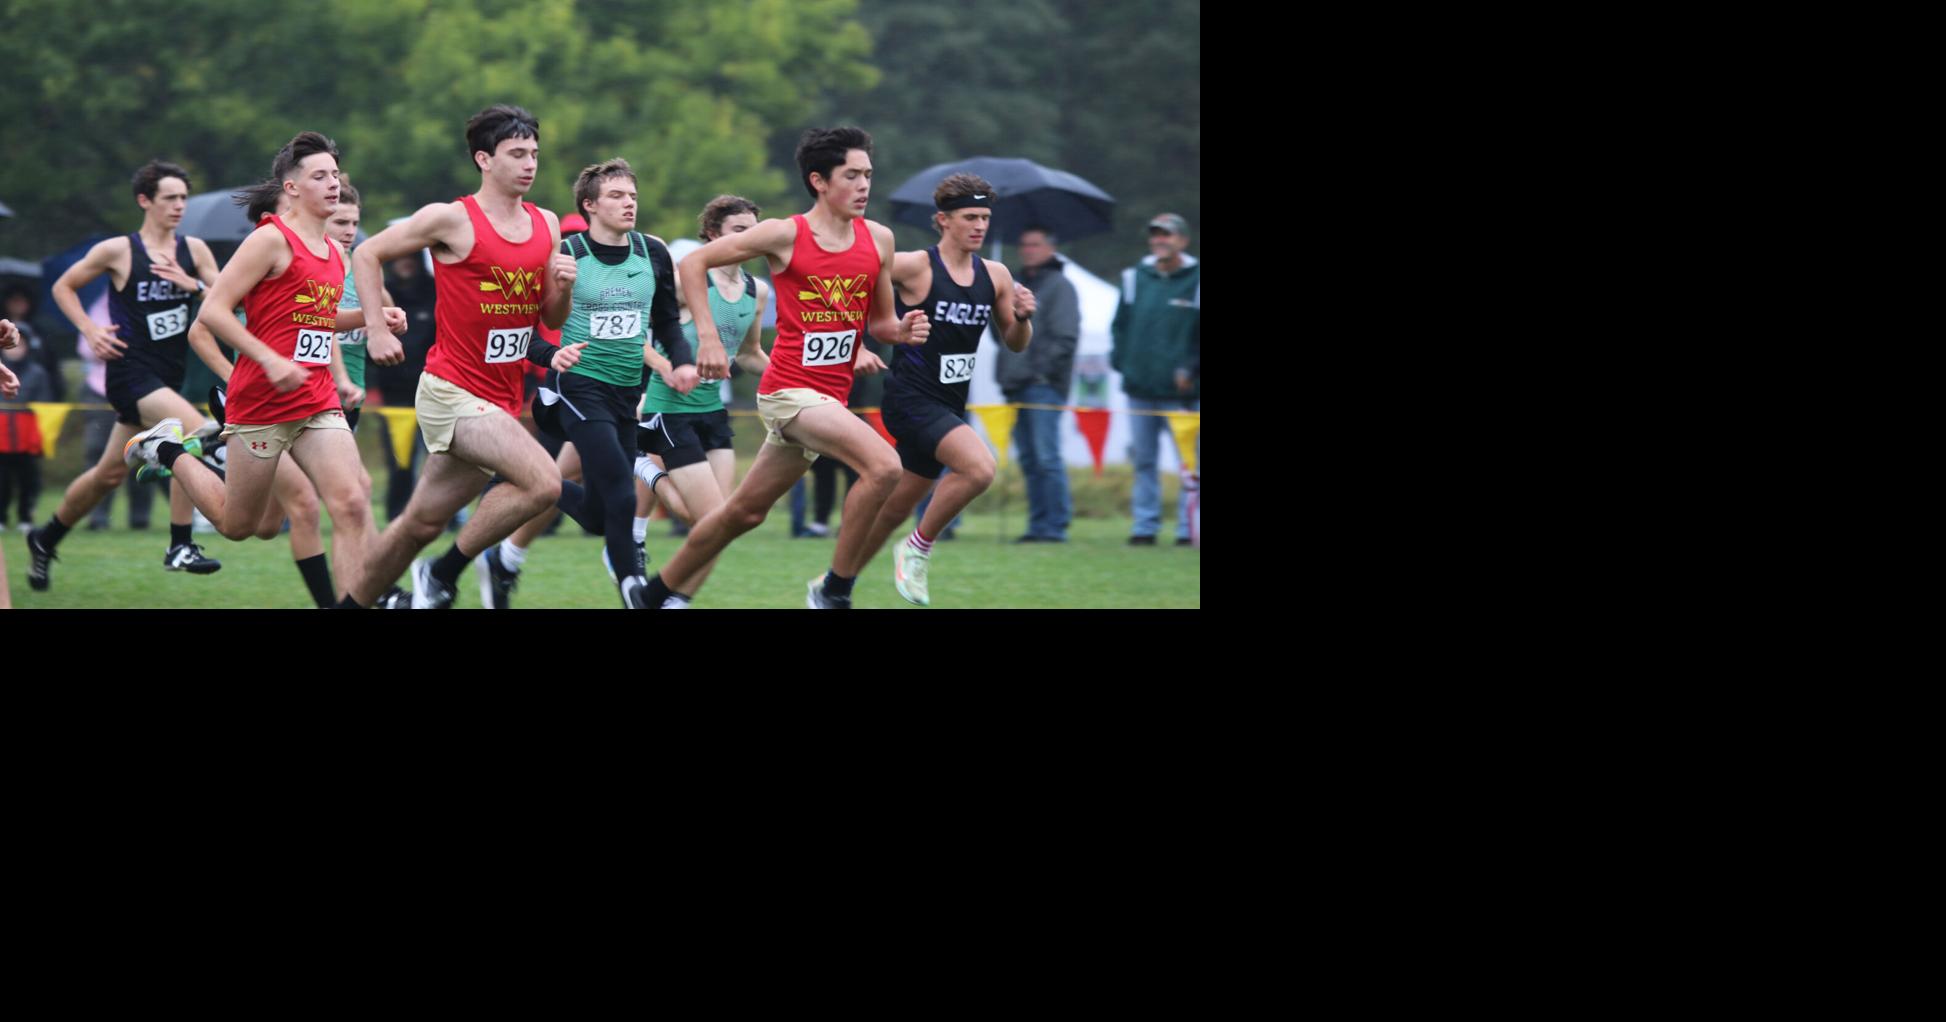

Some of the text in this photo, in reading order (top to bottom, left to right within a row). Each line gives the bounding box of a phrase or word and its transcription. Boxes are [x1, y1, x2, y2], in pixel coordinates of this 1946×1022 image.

[480, 303, 540, 315] WESTVIEW
[801, 311, 864, 322] WESTVIEW
[934, 301, 991, 325] EAGLES
[595, 314, 637, 336] 787
[298, 334, 331, 359] 925
[489, 332, 529, 358] 930
[807, 335, 853, 361] 926
[944, 357, 976, 378] 829
